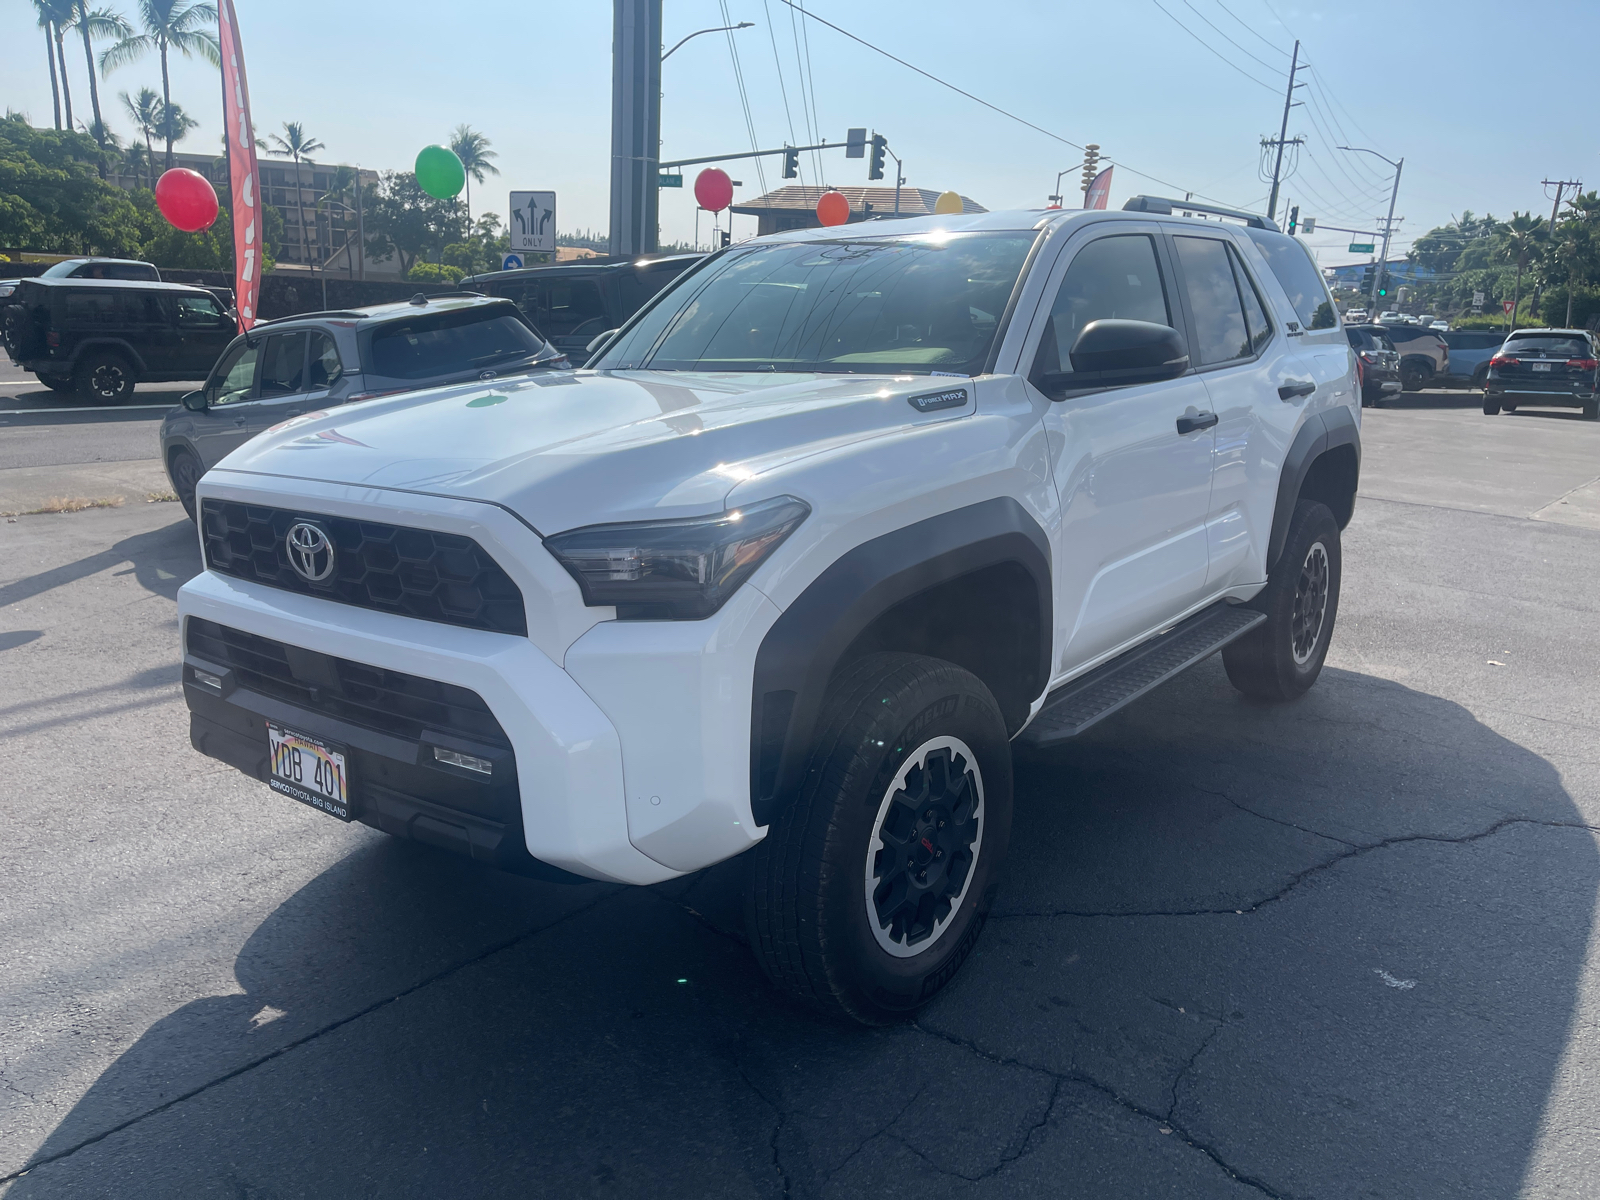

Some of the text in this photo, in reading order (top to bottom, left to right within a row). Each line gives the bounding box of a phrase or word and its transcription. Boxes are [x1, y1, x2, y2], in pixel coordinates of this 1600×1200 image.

[522, 237, 543, 247] ONLY
[942, 391, 964, 401] MAX
[270, 738, 342, 800] YDB 401
[324, 801, 347, 818] ISLAND
